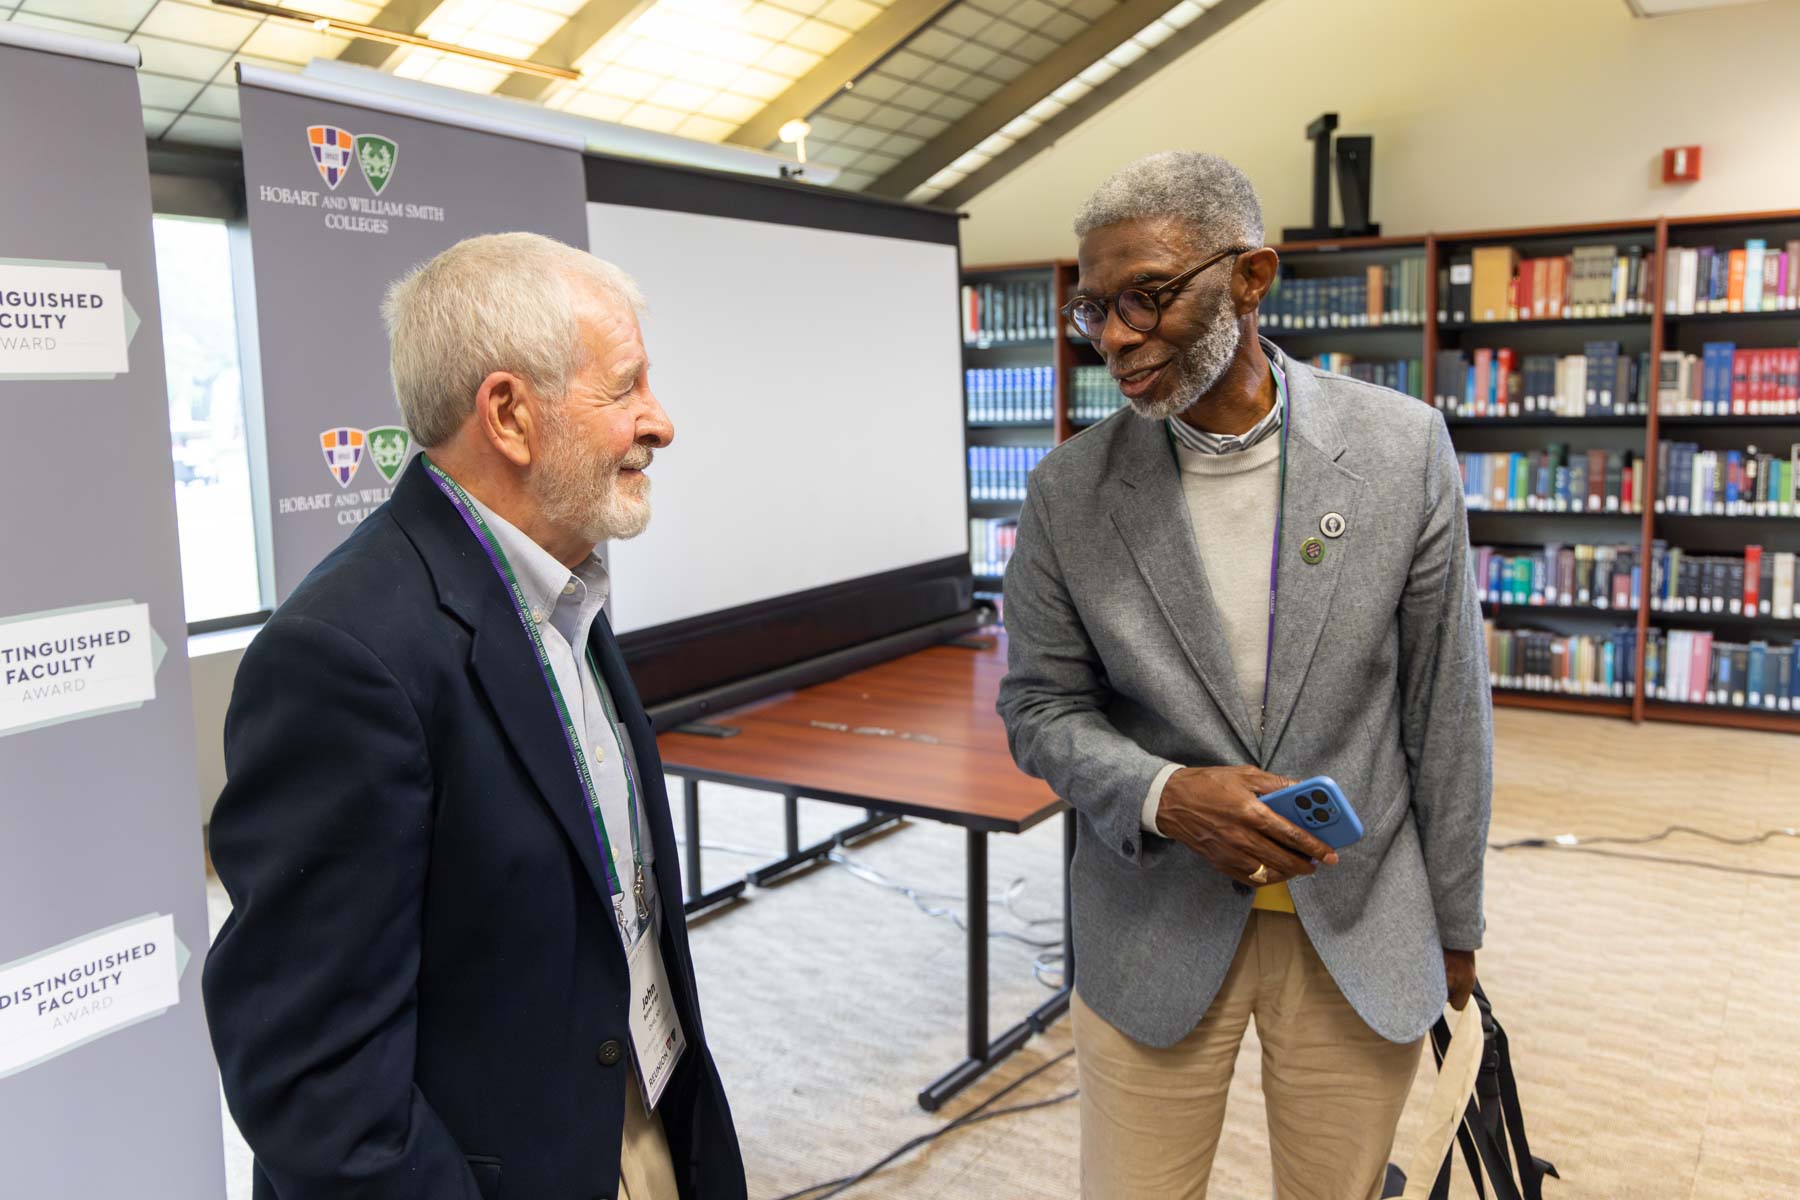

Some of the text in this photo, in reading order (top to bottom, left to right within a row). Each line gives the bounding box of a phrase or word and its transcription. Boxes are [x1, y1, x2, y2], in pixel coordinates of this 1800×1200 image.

[260, 185, 444, 222] HOBART AND WILLIAM SMITH
[325, 213, 389, 234] COLLEGES
[0, 291, 104, 309] GUISHED
[0, 313, 67, 329] CULTY
[279, 493, 333, 514] HOBART
[334, 493, 360, 507] AND
[469, 506, 484, 525] SMITH
[511, 582, 550, 666] HOBART AND WILLIAM SMITH
[1, 629, 132, 664] TINGUISHED
[6, 654, 96, 685] FACULTY
[22, 678, 87, 703] AWARD
[567, 725, 599, 809] HOBART AND WILLIAM SMITH
[0, 942, 157, 1010] DISTINGUISHED
[38, 971, 122, 1017] FACULTY
[642, 984, 656, 1010] John
[53, 996, 114, 1030] AWARD
[648, 1050, 669, 1088] REUNION
